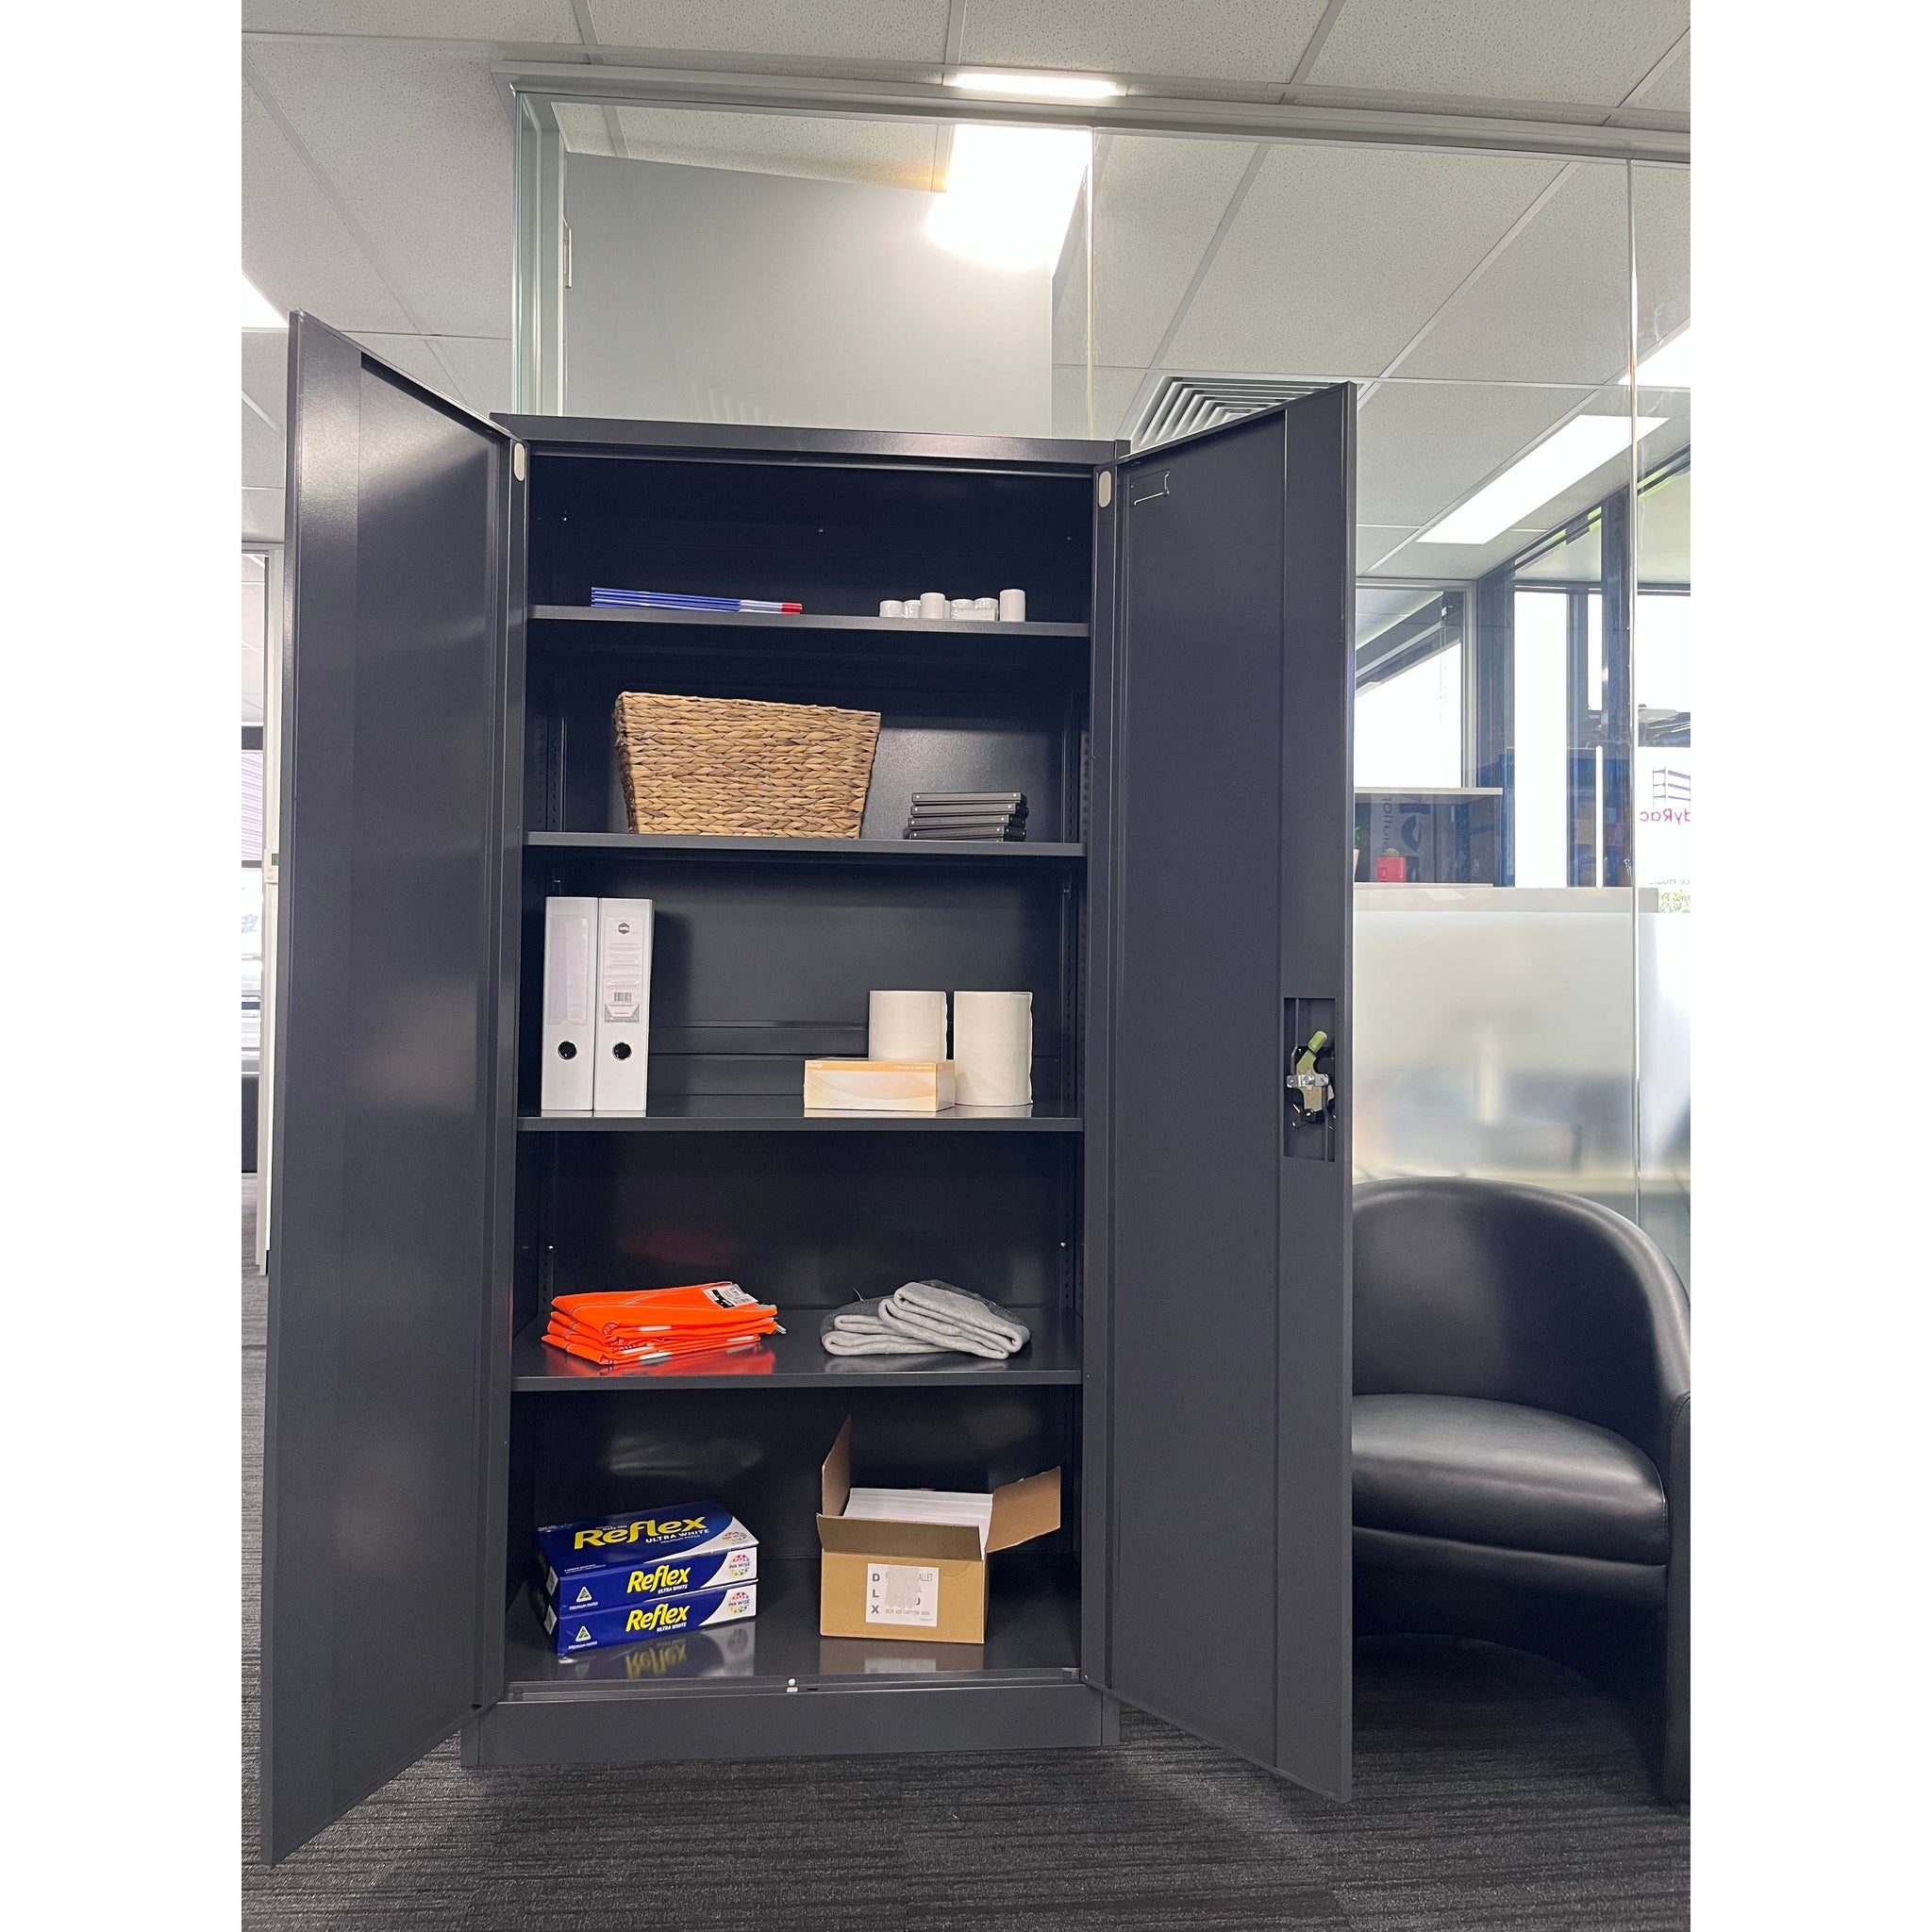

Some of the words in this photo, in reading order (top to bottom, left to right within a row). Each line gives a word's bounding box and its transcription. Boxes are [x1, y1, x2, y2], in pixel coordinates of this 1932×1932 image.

[574, 1516, 708, 1550] Reflex
[645, 1533, 677, 1543] ULTRA
[678, 1528, 710, 1538] WHITE
[626, 1564, 691, 1593] Reflex
[918, 1573, 933, 1582] ALLET
[625, 1603, 691, 1633] Reflex
[657, 1624, 671, 1633] ULTRA
[672, 1622, 687, 1630] WHITE
